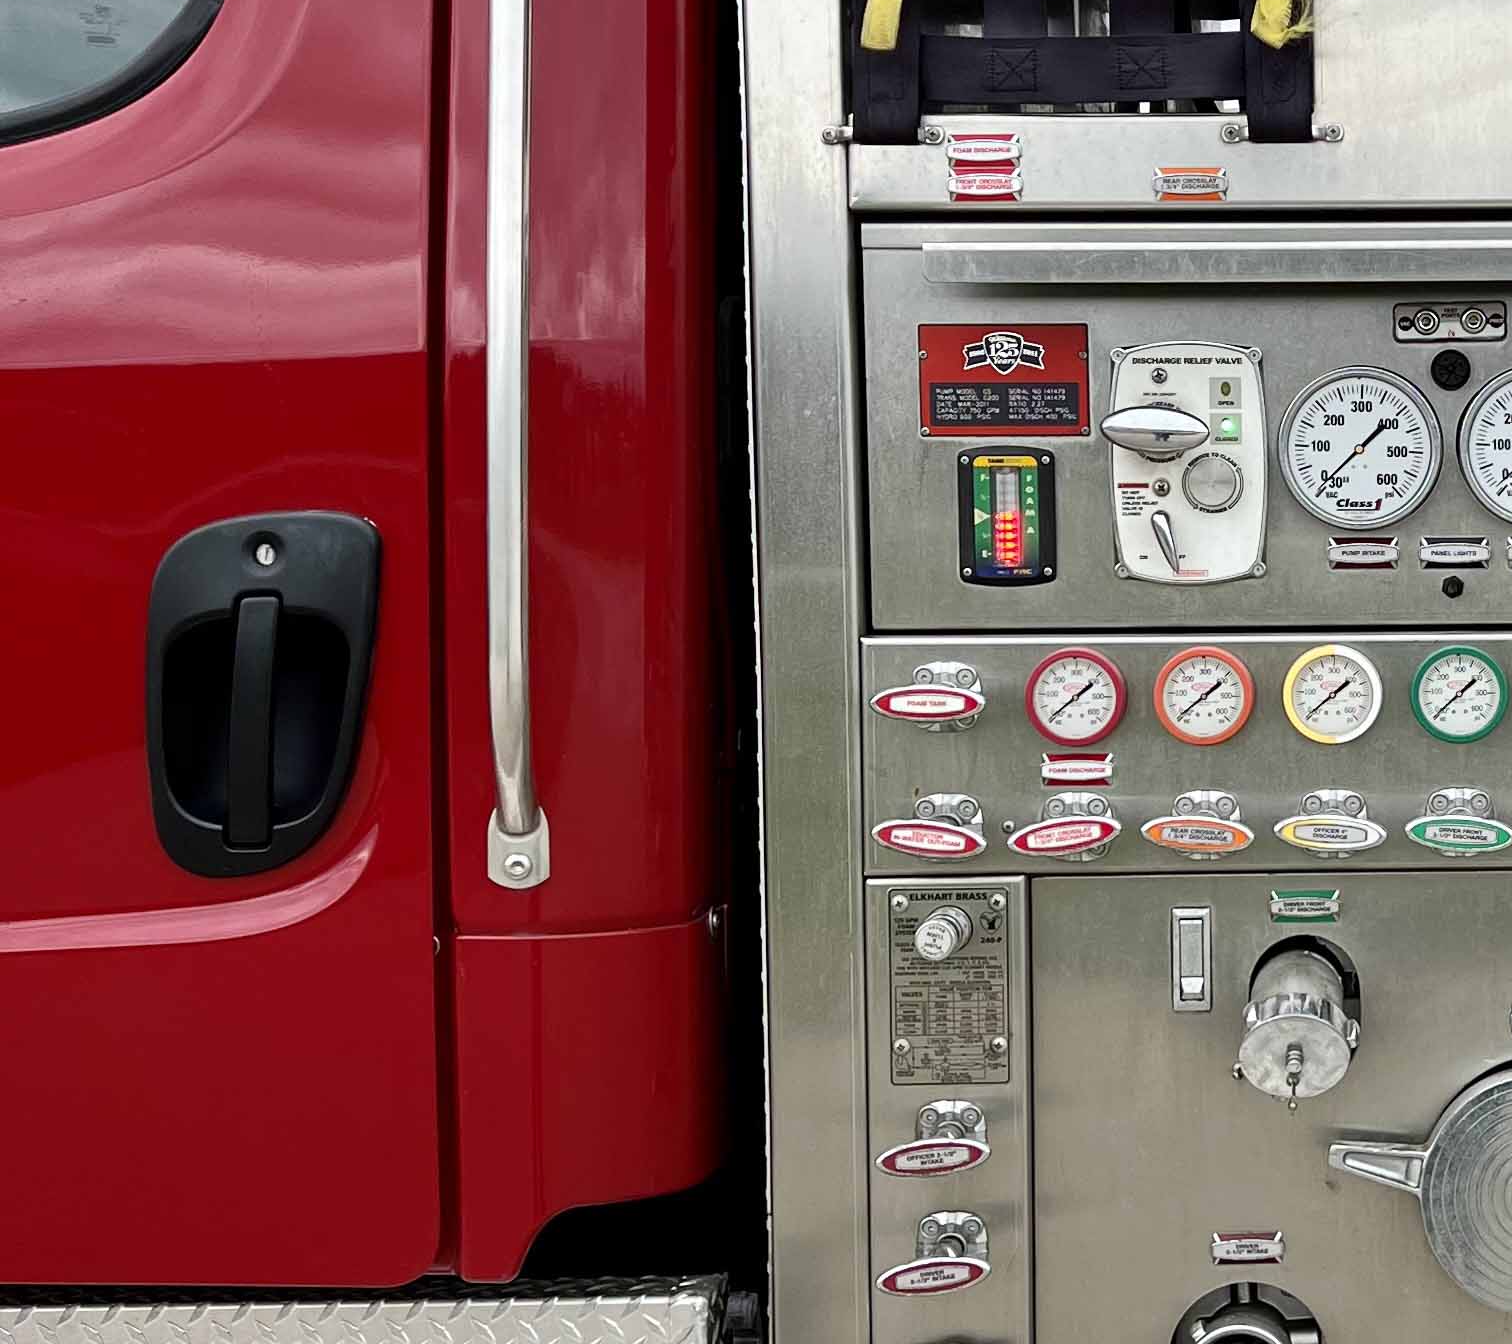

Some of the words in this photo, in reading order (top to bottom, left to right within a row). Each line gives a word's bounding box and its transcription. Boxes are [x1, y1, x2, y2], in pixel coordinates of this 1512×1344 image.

[989, 341, 1019, 358] 125
[1132, 357, 1182, 365] DISCHARGE
[1184, 357, 1212, 365] RELIEF
[1215, 357, 1243, 365] VALVE
[1351, 401, 1372, 413] 300
[1323, 414, 1345, 426] 200
[1377, 418, 1399, 430] 400
[1311, 440, 1330, 452] 100
[1492, 438, 1511, 450] 100
[1387, 446, 1408, 458] 500
[1376, 473, 1398, 485] 600
[1188, 834, 1228, 842] DISCHARGE
[1452, 833, 1488, 841] DISCHARGE
[909, 893, 954, 902] ELKHART
[955, 892, 988, 900] BRASS
[906, 1152, 936, 1163] OFFICER
[920, 1158, 944, 1166] INTAKE
